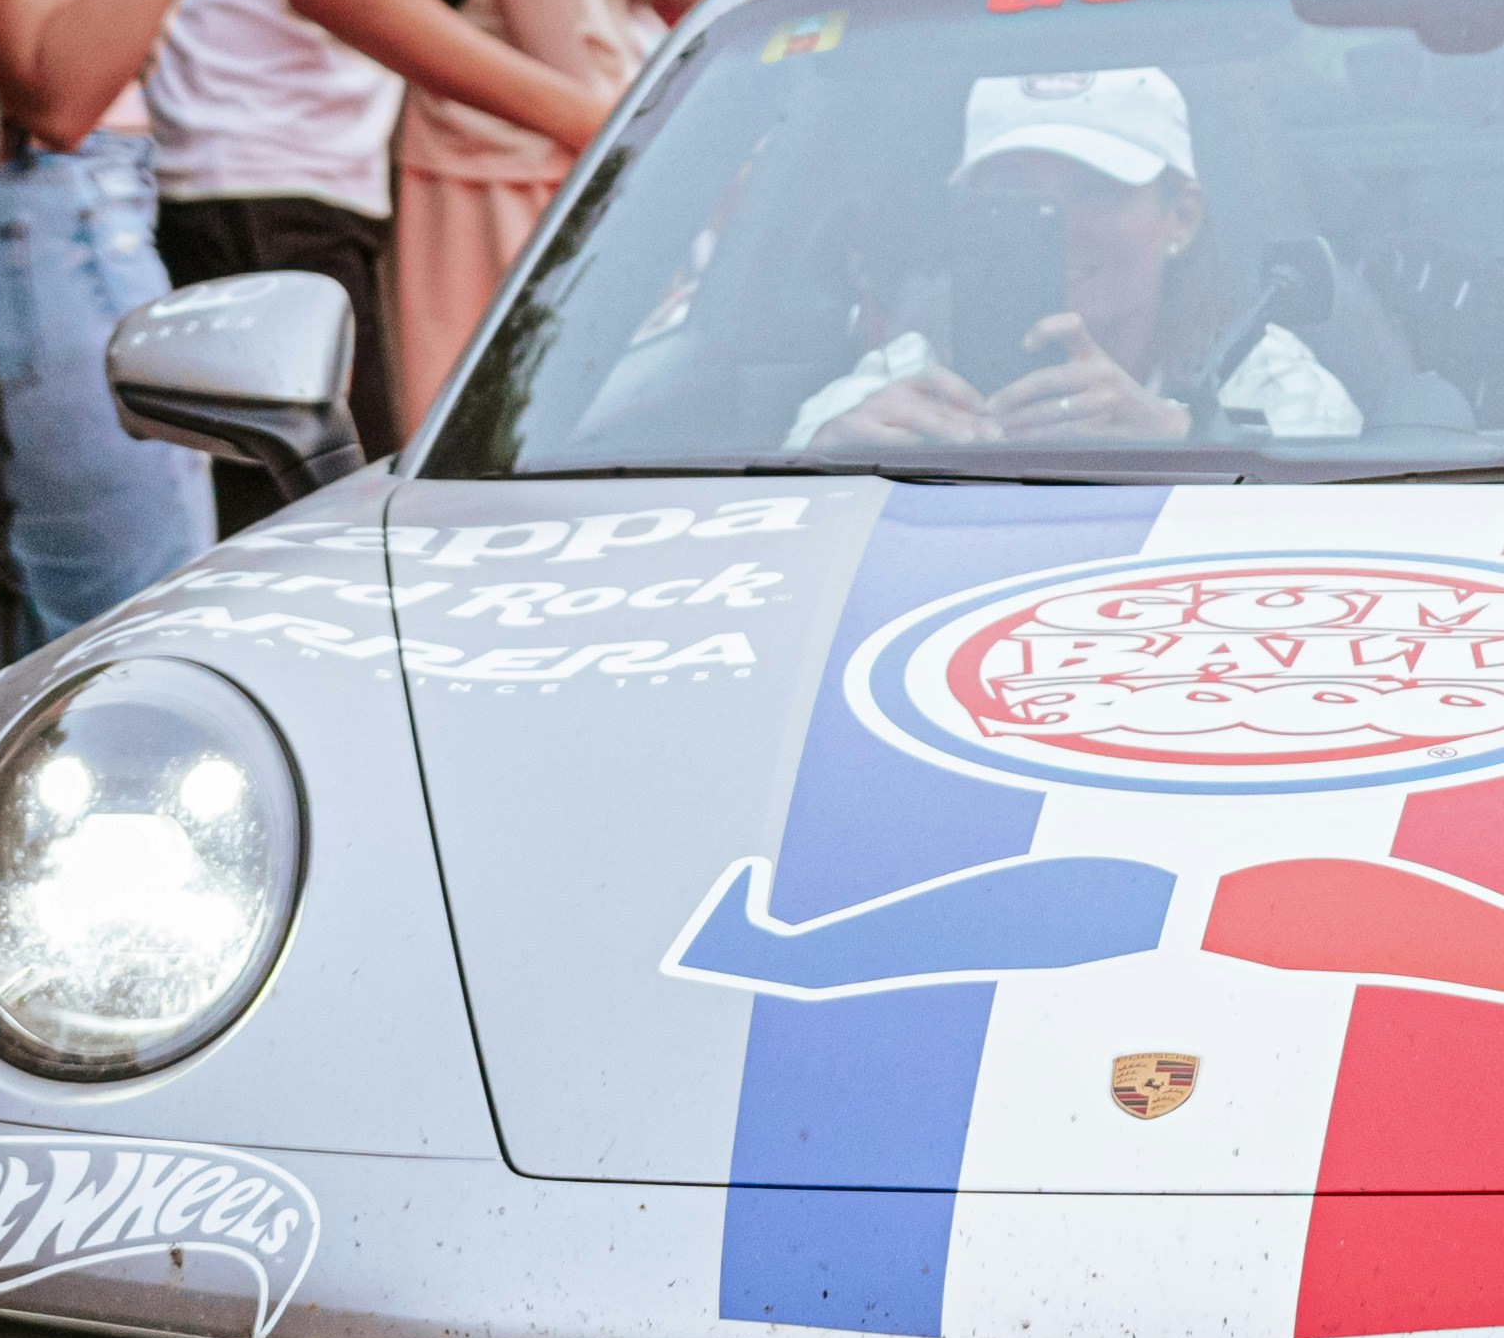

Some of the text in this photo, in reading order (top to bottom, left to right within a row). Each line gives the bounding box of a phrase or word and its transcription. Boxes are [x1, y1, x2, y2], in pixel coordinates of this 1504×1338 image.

[446, 562, 785, 627] Rock
[52, 606, 758, 681] CARRERA
[375, 667, 752, 694] SINCE 1956
